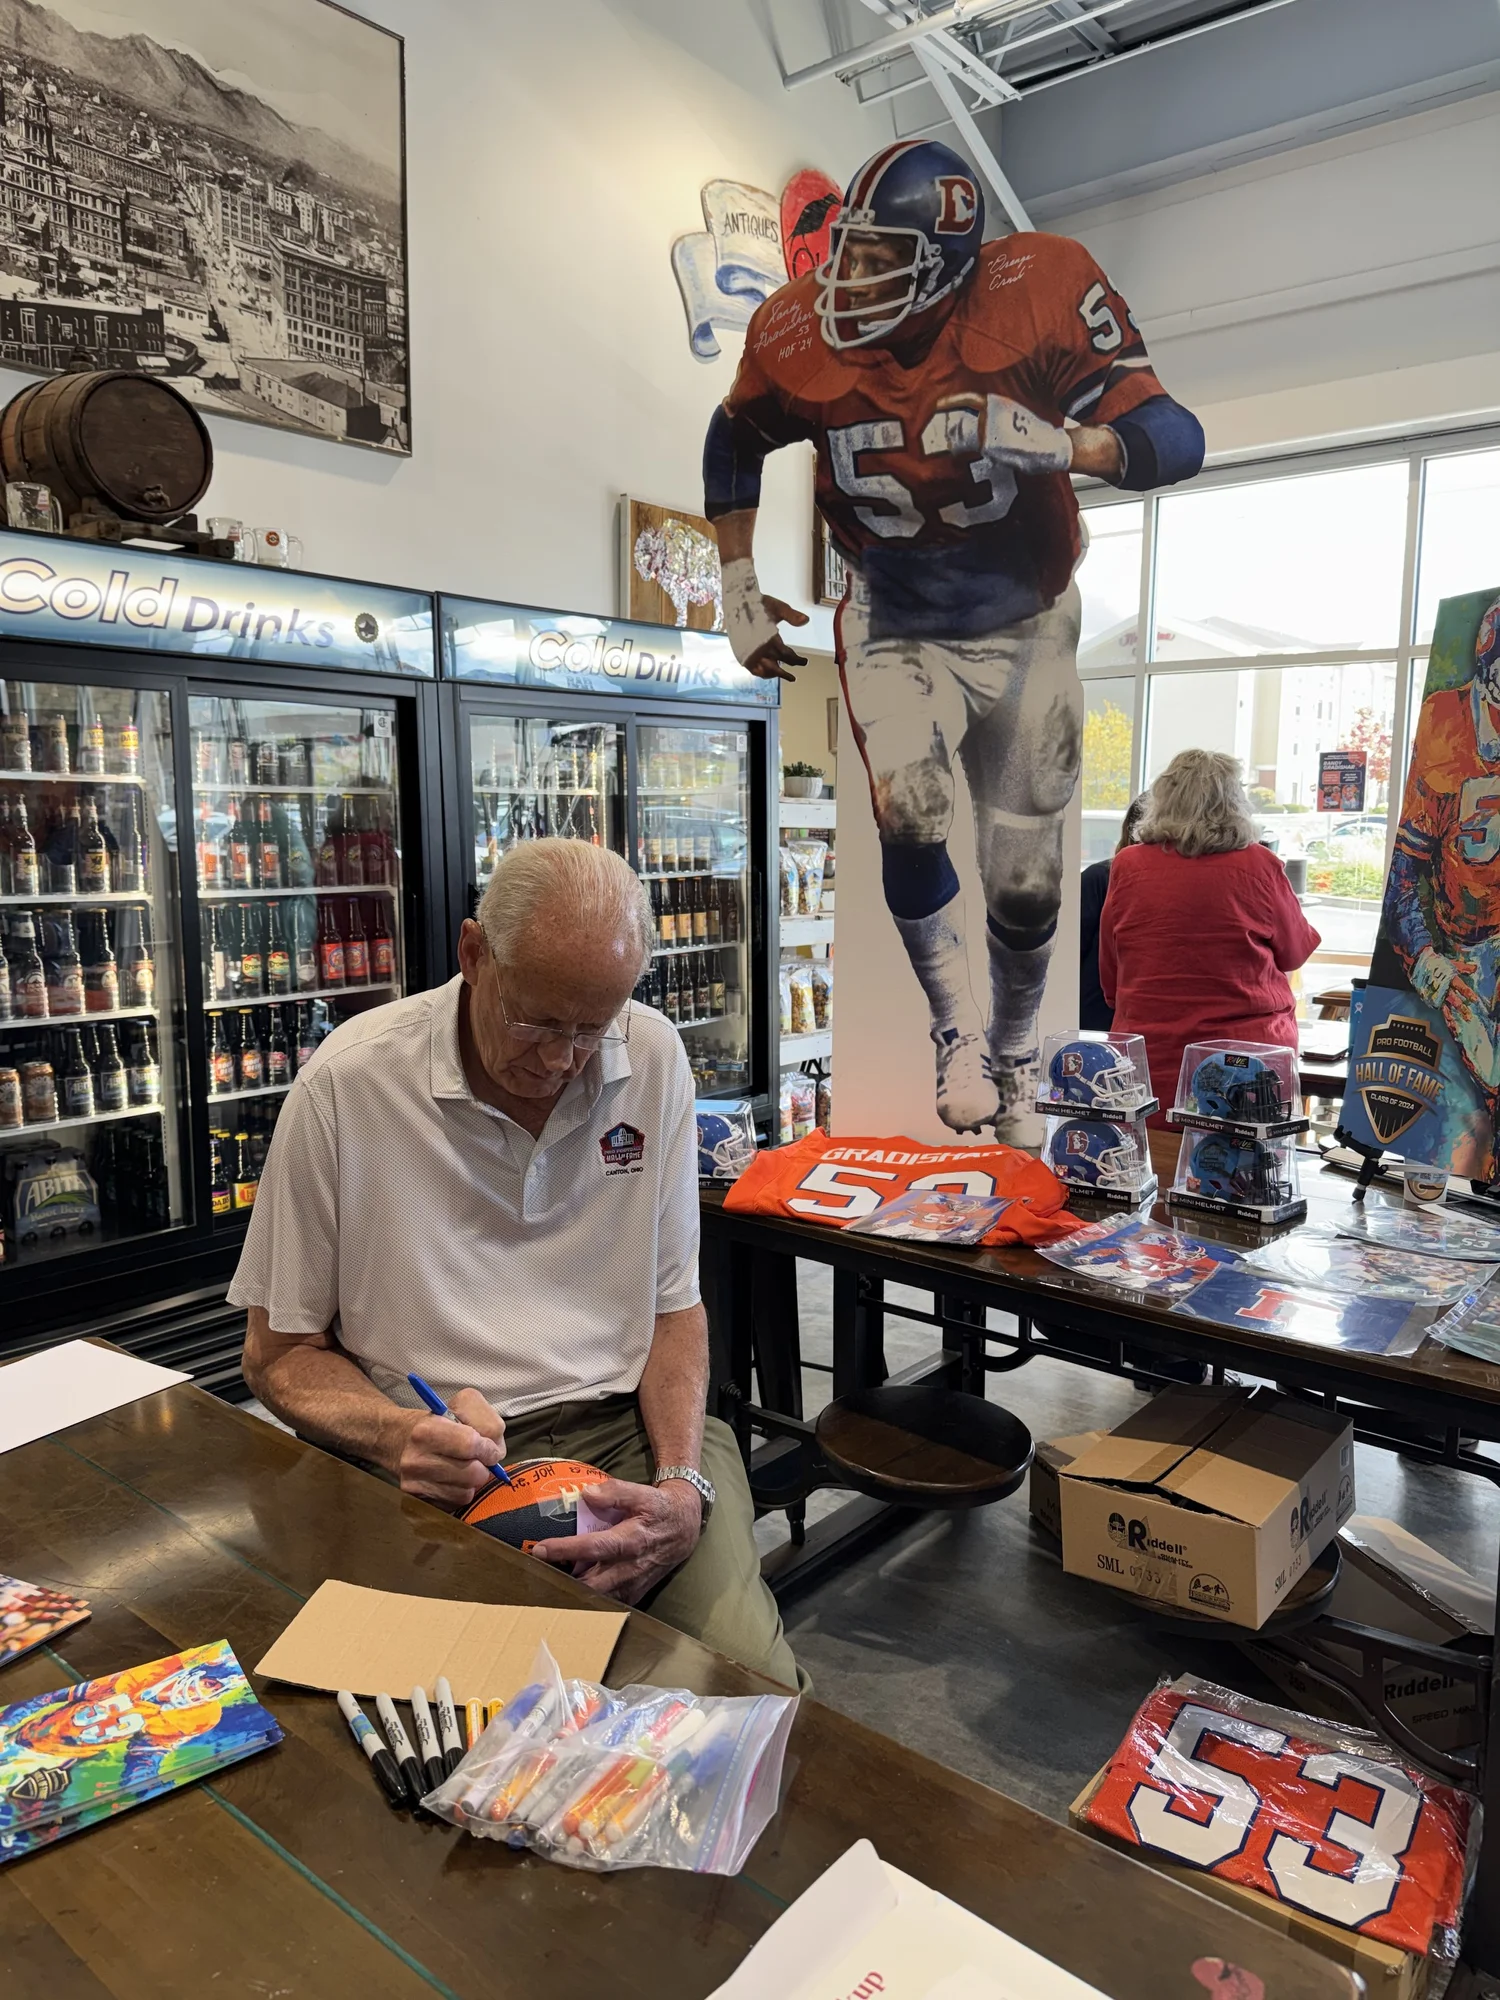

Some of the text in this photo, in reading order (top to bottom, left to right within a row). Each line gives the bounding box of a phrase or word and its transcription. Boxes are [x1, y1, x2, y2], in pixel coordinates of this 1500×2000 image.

[723, 212, 779, 243] ANTIQUES
[778, 342, 797, 362] HOF
[0, 557, 335, 649] Cold Drinks
[529, 629, 722, 687] Cold Drinks
[1376, 1038, 1432, 1058] PRO FOOTBALL
[1355, 1062, 1444, 1102] HALL OF FAME
[1370, 1093, 1389, 1104] CLASS
[1398, 1100, 1415, 1110] 2024
[1061, 1108, 1091, 1117] HELMET
[1196, 1120, 1224, 1130] HELMET
[1234, 1128, 1255, 1136] Riddell
[25, 1175, 88, 1216] ABITA
[1069, 1187, 1128, 1201] ELMET Riddell
[1180, 1197, 1259, 1219] MINI HELMET Riddell
[922, 1213, 966, 1225] 53
[1461, 1238, 1490, 1248] 53
[532, 1465, 555, 1483] HOF
[1097, 1554, 1125, 1575] SML
[1384, 1676, 1454, 1701] Riddell
[71, 1692, 146, 1745] 53
[1412, 1709, 1449, 1724] SPEED
[1125, 1702, 1424, 1932] 53
